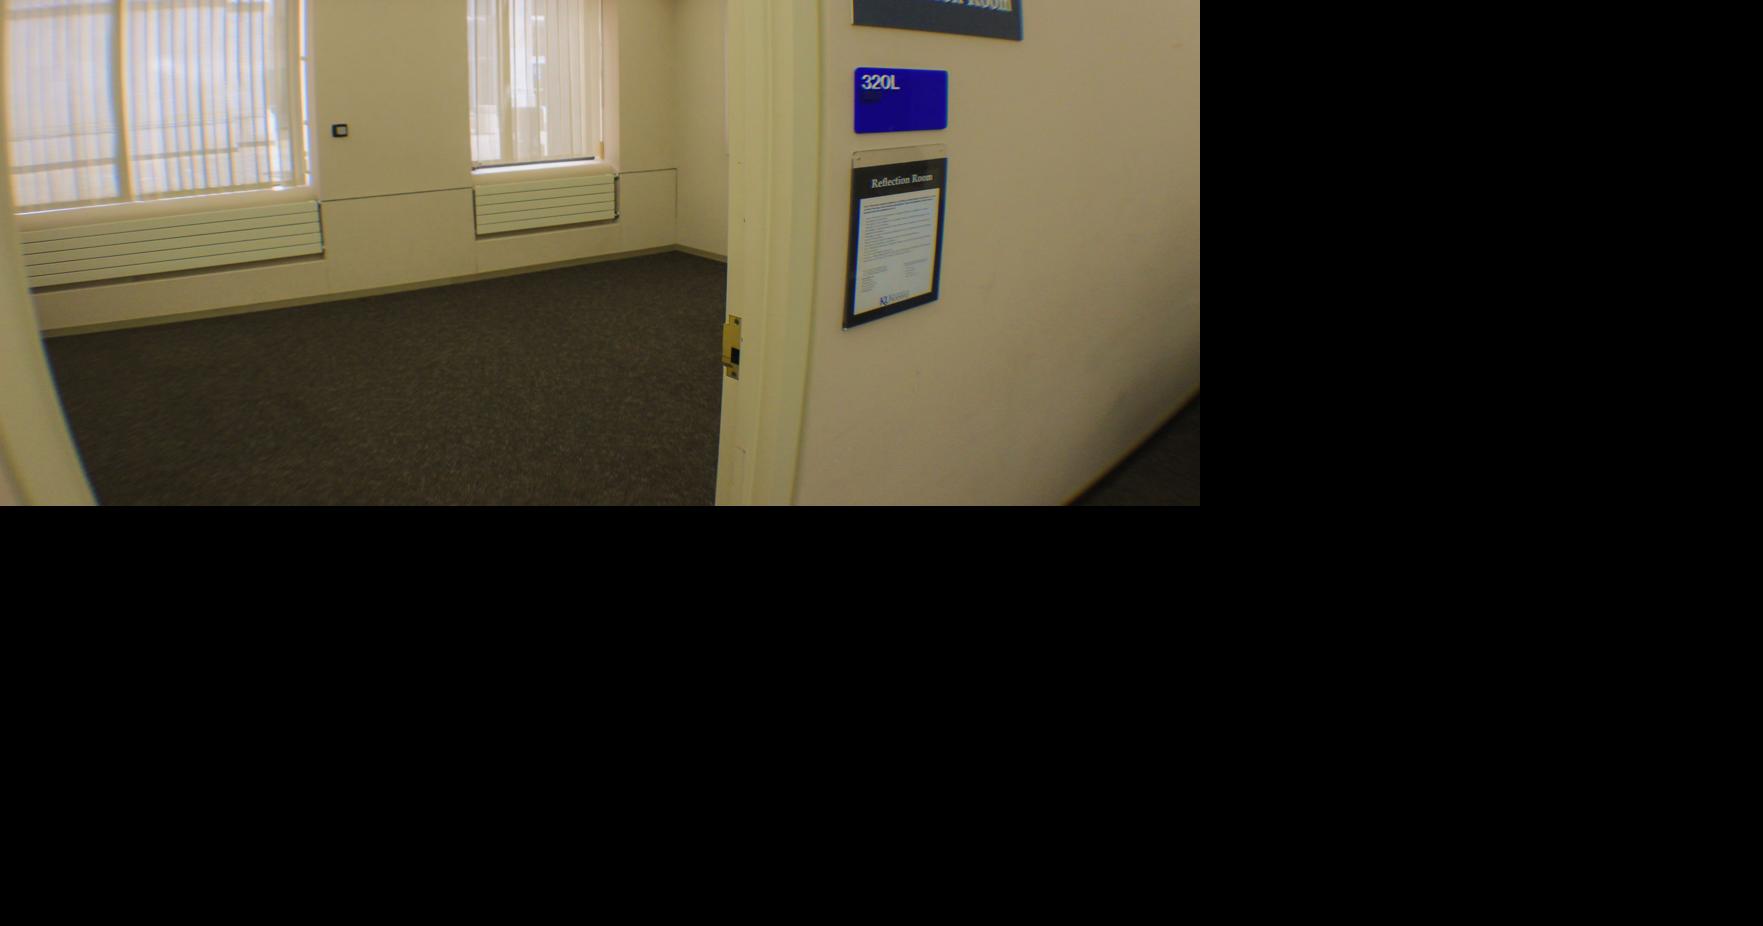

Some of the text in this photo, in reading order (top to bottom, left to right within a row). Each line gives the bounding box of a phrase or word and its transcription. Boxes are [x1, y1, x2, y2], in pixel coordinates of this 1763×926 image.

[861, 74, 900, 90] 320L
[872, 174, 933, 188] Reflection Room
